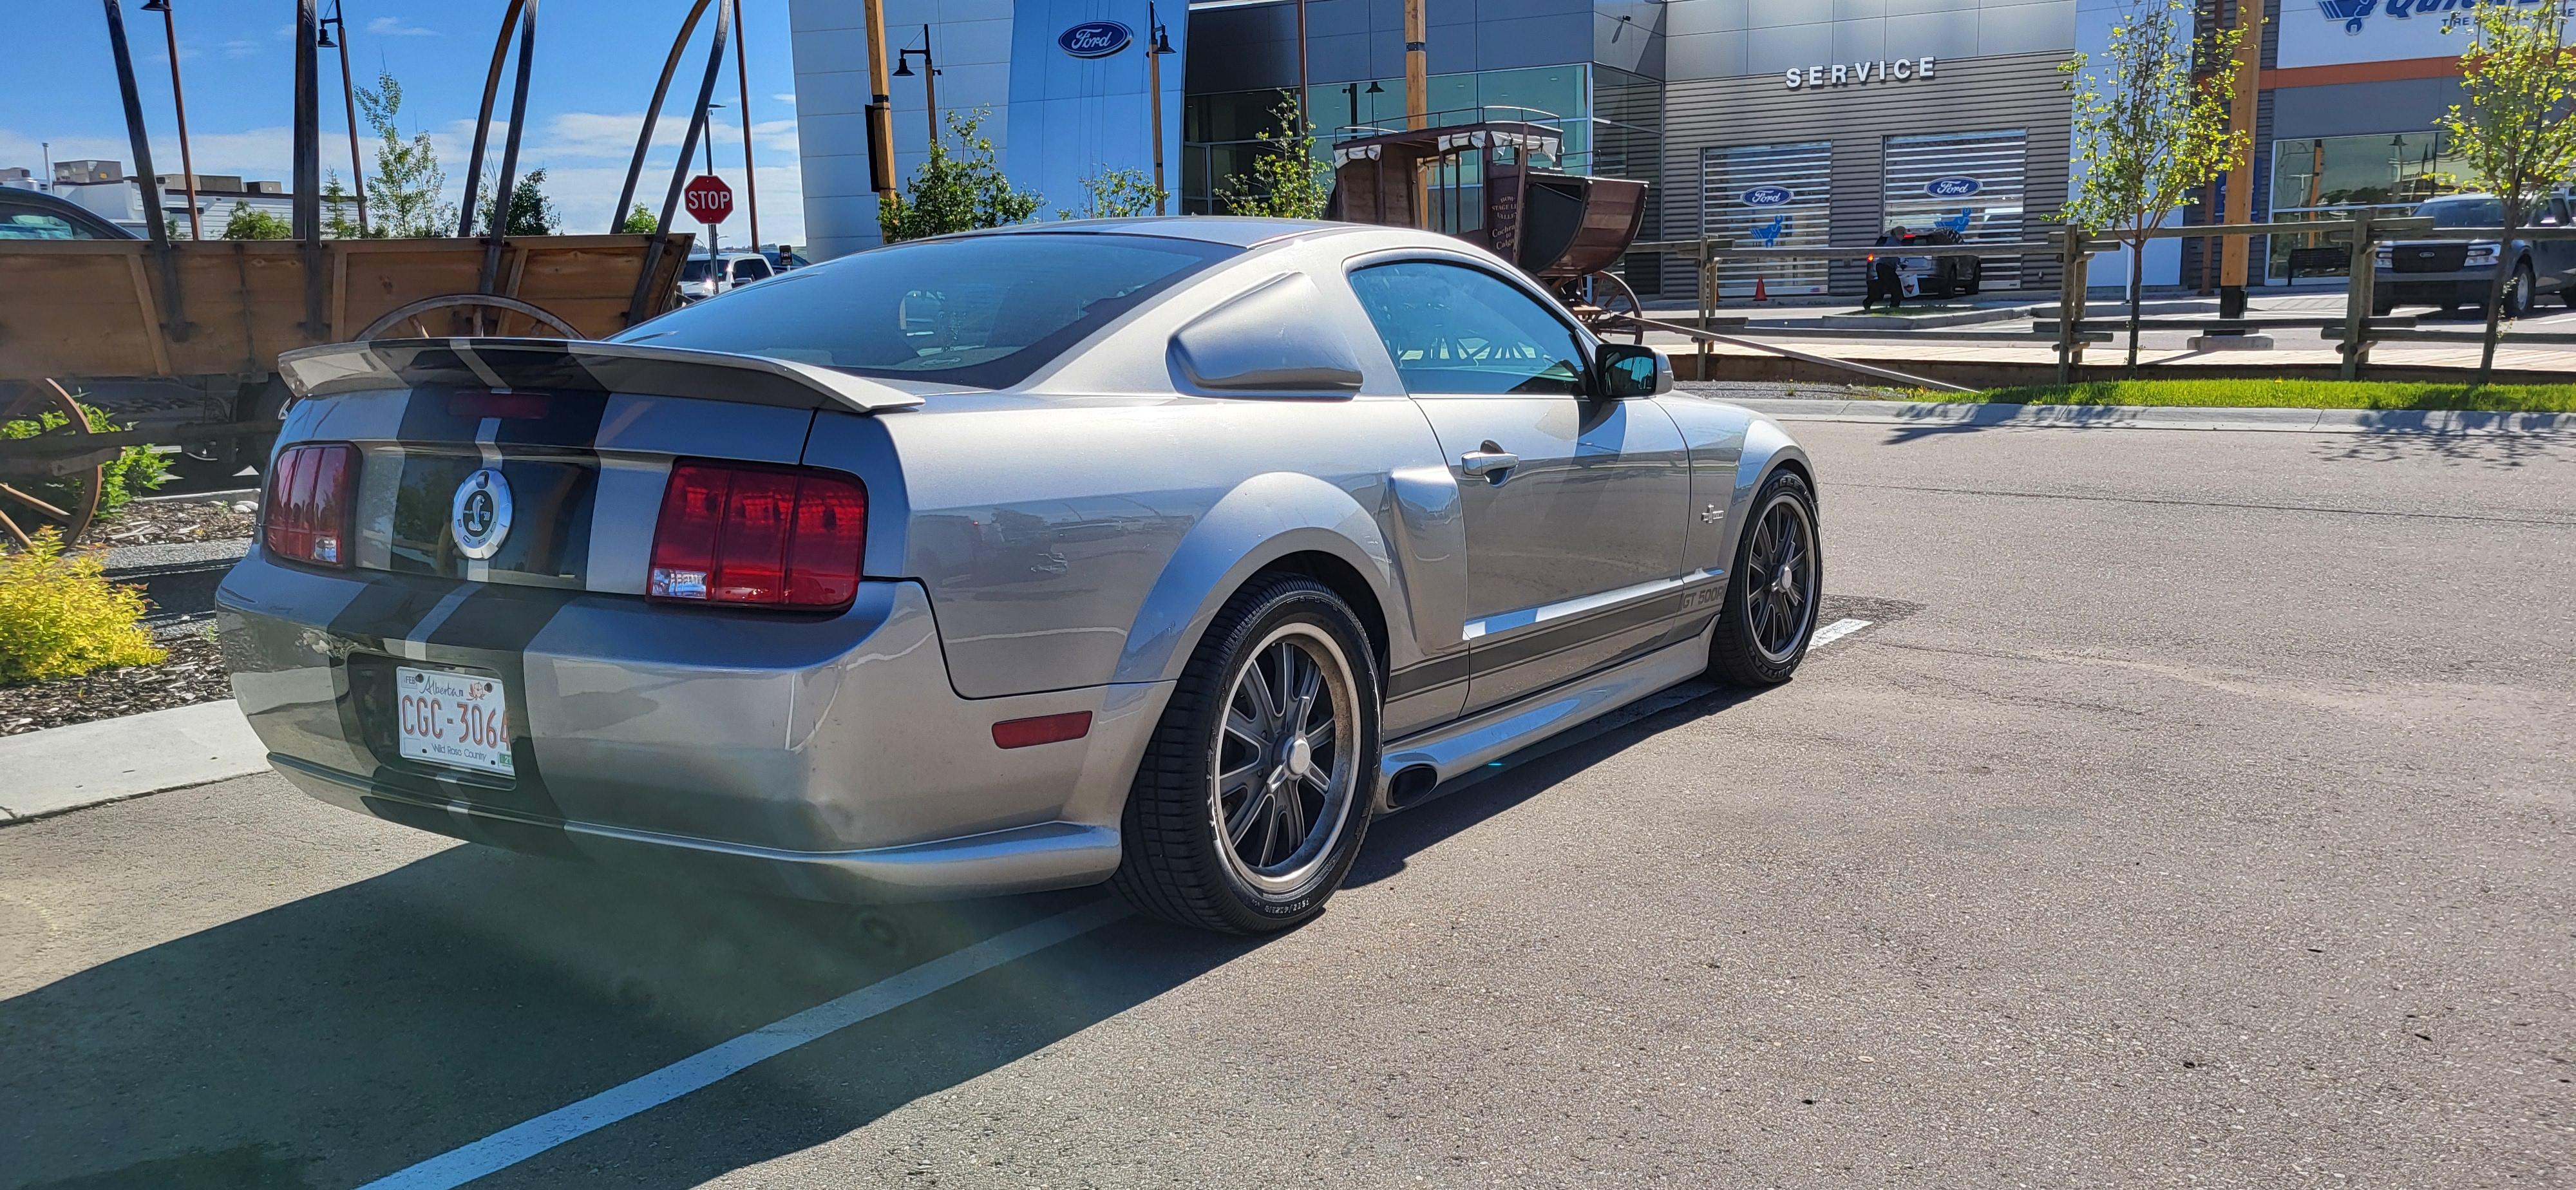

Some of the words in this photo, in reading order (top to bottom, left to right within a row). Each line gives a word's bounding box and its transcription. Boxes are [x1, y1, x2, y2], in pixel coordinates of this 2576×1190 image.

[1072, 28, 1113, 49] Ford
[1786, 57, 1935, 88] SERVICE
[1937, 181, 1969, 194] Ford
[688, 191, 730, 209] STOP
[1752, 190, 1781, 203] Ford
[1492, 225, 1515, 238] Cochra
[1496, 238, 1514, 250] Calga
[1683, 592, 1697, 608] GT
[405, 675, 416, 685] FEB
[420, 675, 462, 697] Alberta
[402, 695, 510, 751] CGC-3064
[431, 743, 446, 753] Wild
[464, 748, 487, 762] Country
